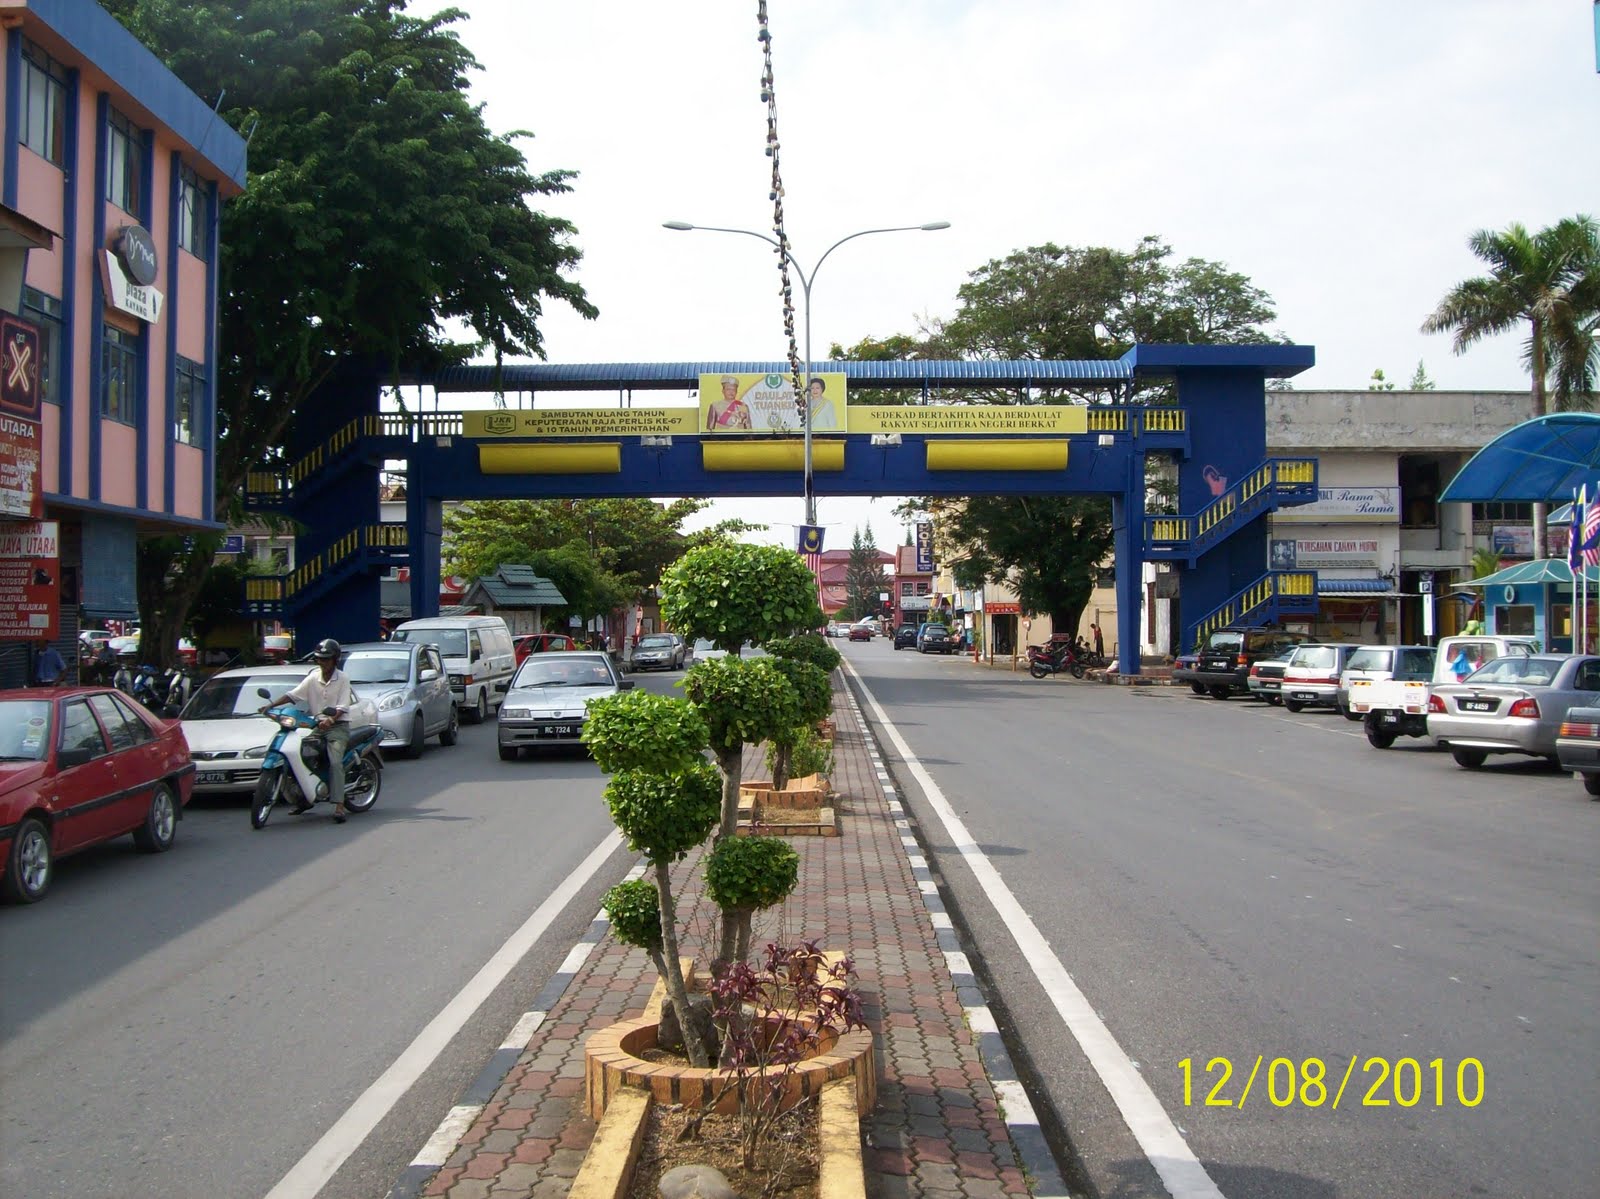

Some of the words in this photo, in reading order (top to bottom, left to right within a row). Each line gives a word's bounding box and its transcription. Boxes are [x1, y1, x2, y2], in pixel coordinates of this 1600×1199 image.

[540, 411, 595, 419] SAMBUTAN
[870, 411, 916, 419] SEDEKAD
[918, 411, 975, 419] BERTAKHTA
[978, 411, 1002, 419] RAJA
[1004, 411, 1062, 419] BERDAULAT
[0, 417, 35, 439] UTARA
[880, 420, 919, 428] RAKYAT
[921, 420, 977, 428] SEJAHTERA
[979, 420, 1016, 428] NEGERI
[1018, 420, 1057, 428] BERKAT
[594, 425, 670, 433] PEMERINTAHAN
[1337, 490, 1374, 501] Rama
[1355, 502, 1394, 513] Rama
[26, 536, 56, 554] UTARA
[919, 523, 930, 563] HOTEL
[18, 603, 48, 611] RUJUKAN
